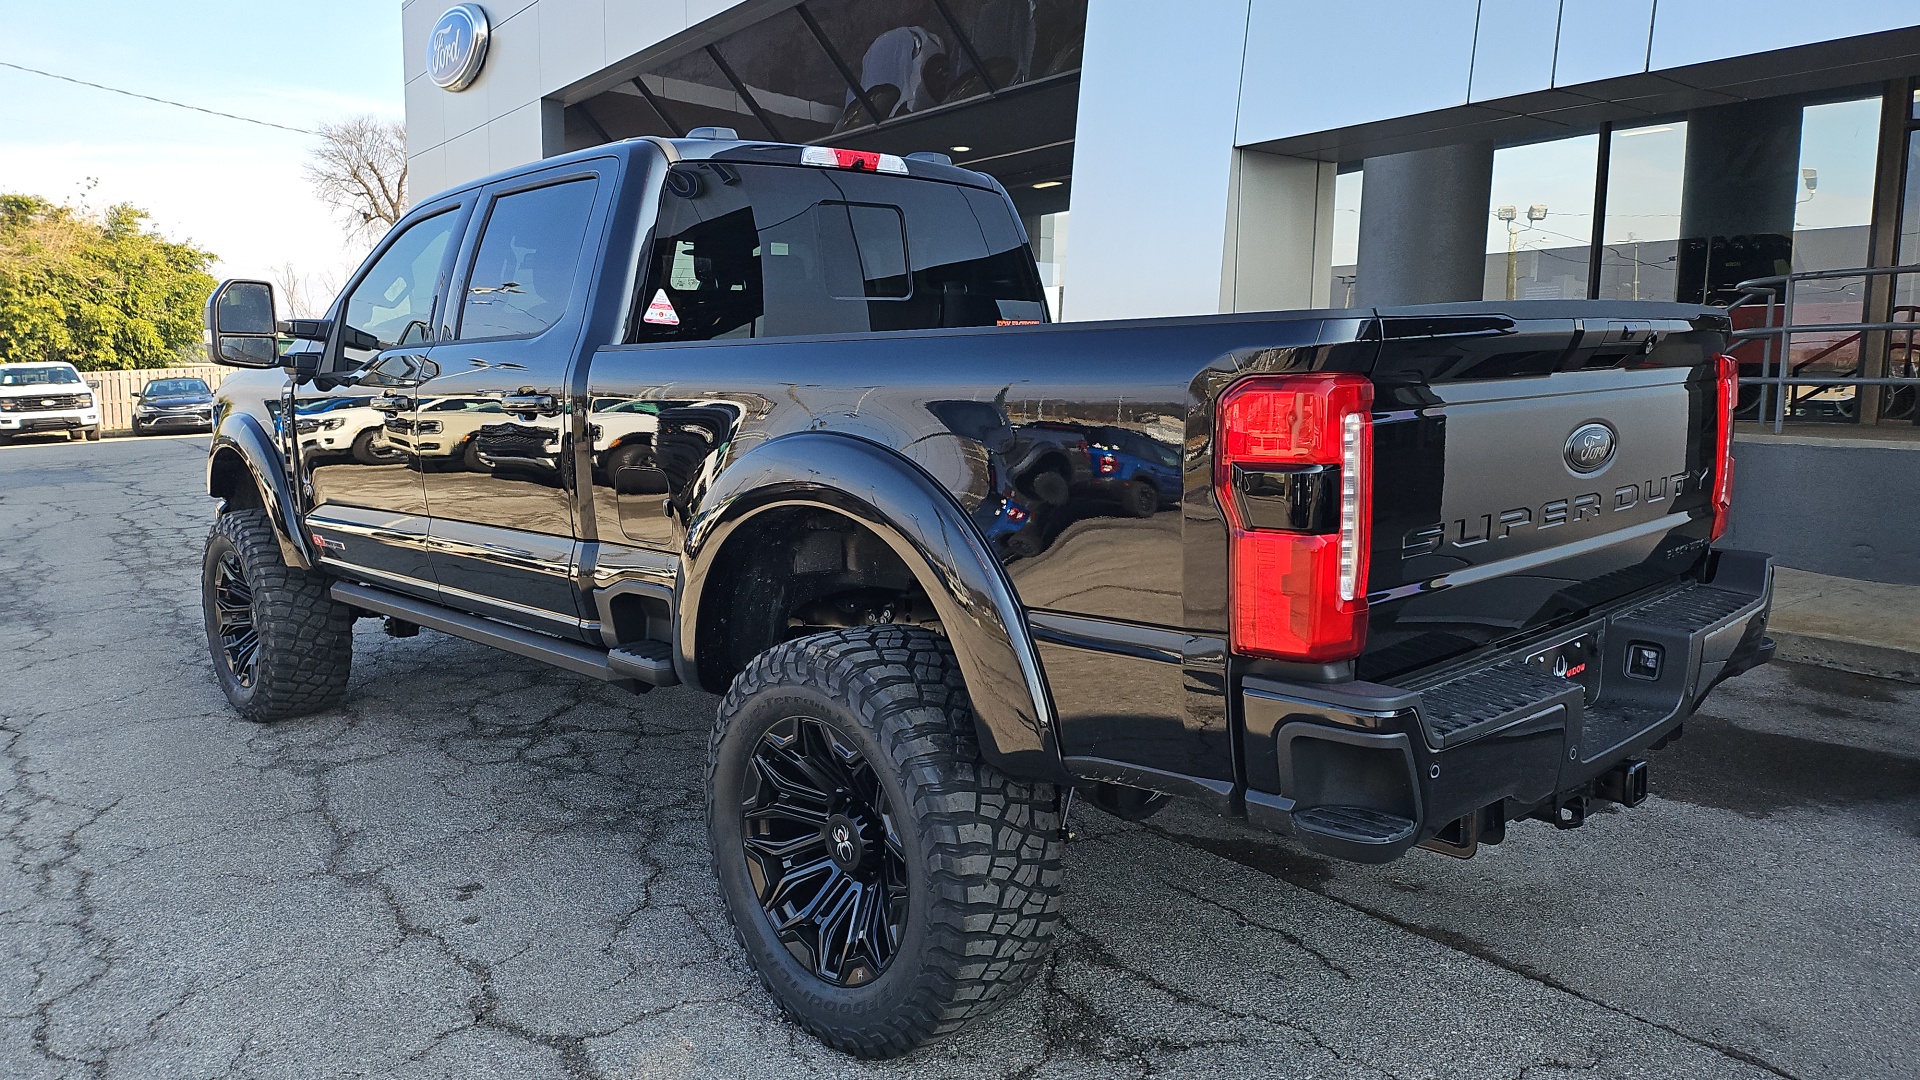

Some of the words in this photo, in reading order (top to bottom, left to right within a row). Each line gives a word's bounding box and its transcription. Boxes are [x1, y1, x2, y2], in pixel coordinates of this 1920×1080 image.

[433, 24, 460, 74] Ford
[1581, 435, 1608, 461] Ford
[1401, 492, 1601, 559] SUPER
[1614, 466, 1709, 512] DUTY
